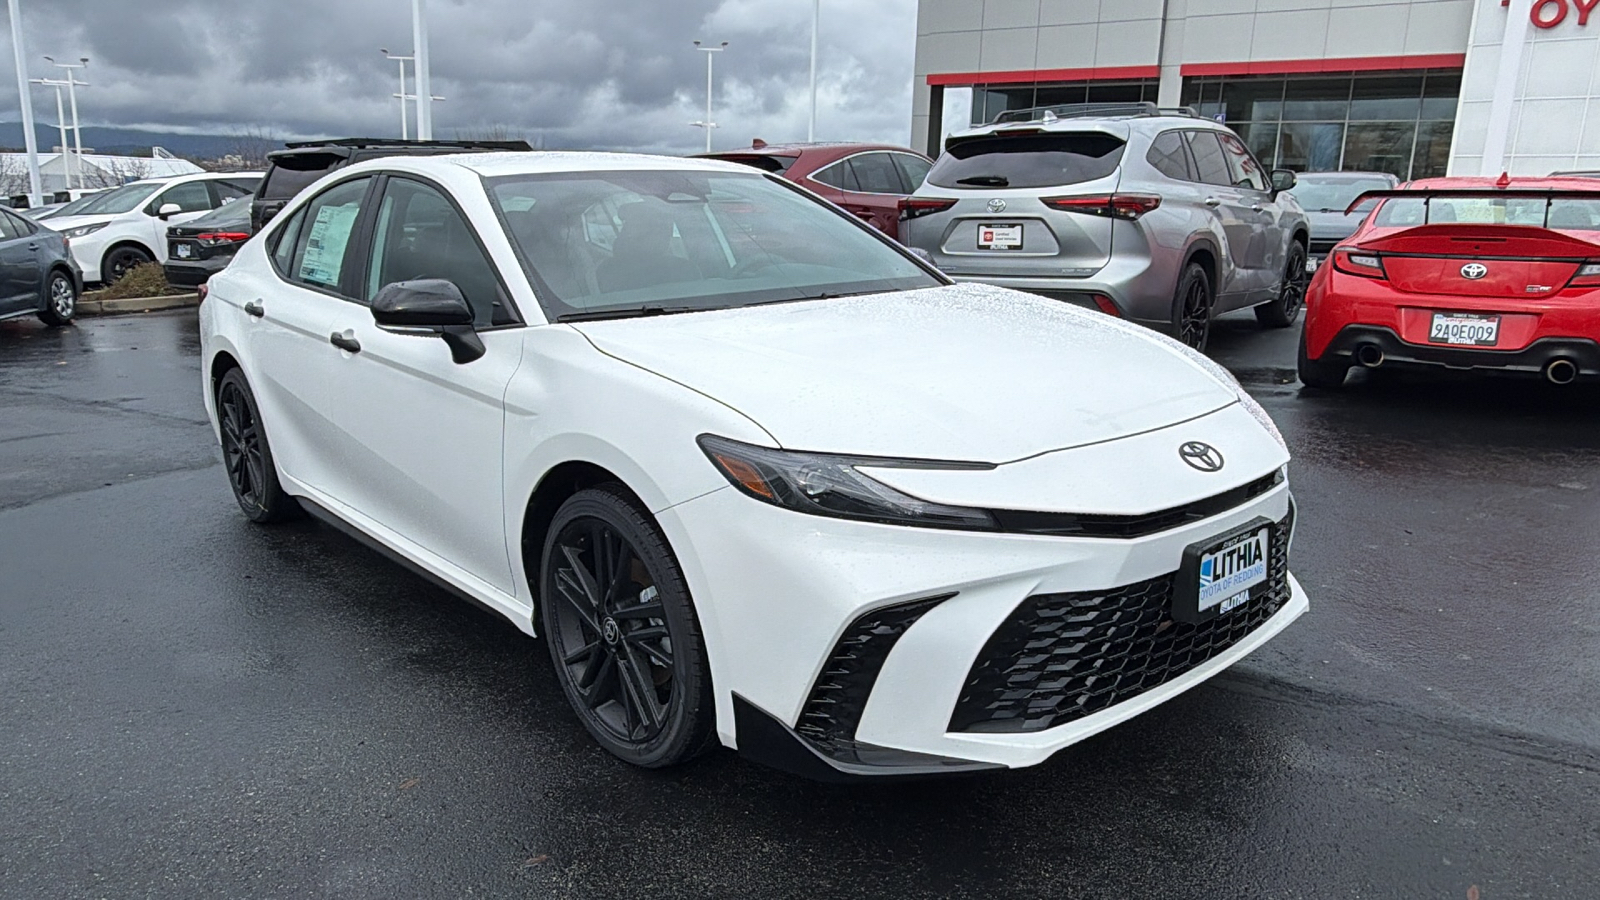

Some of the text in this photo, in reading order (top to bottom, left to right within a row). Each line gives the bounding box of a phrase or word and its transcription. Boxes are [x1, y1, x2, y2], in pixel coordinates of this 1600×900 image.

[1501, 0, 1600, 29] OY
[1435, 323, 1494, 341] 9AQE009
[1212, 538, 1263, 583] LITHIA
[1200, 563, 1264, 600] OYOTA OF REDDING
